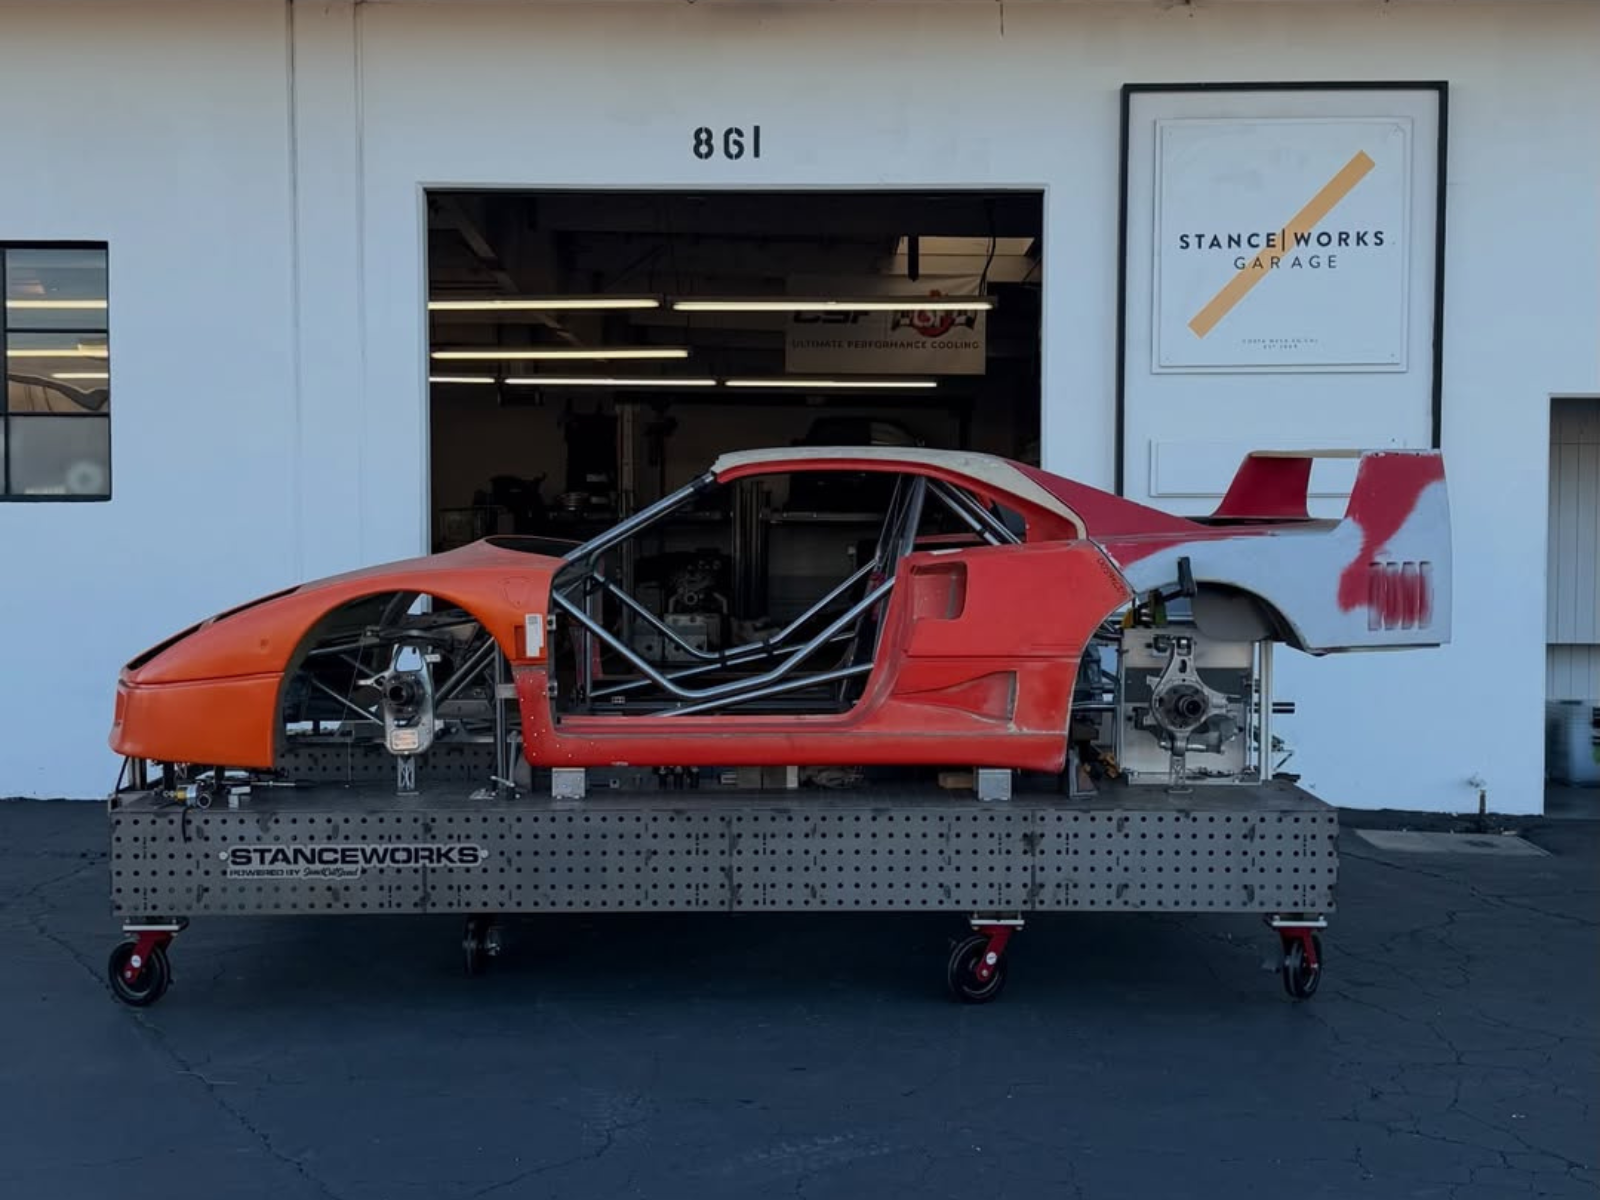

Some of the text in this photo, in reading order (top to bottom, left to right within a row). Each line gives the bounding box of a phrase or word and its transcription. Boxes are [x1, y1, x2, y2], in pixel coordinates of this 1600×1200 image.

[693, 125, 760, 160] 861
[1234, 255, 1338, 270] GARAGE
[792, 340, 979, 349] ULTIMATE PERFORMANCE COOLING
[230, 846, 479, 866] STANCEWORKS
[229, 869, 284, 877] POWERED
[286, 869, 300, 877] BY
